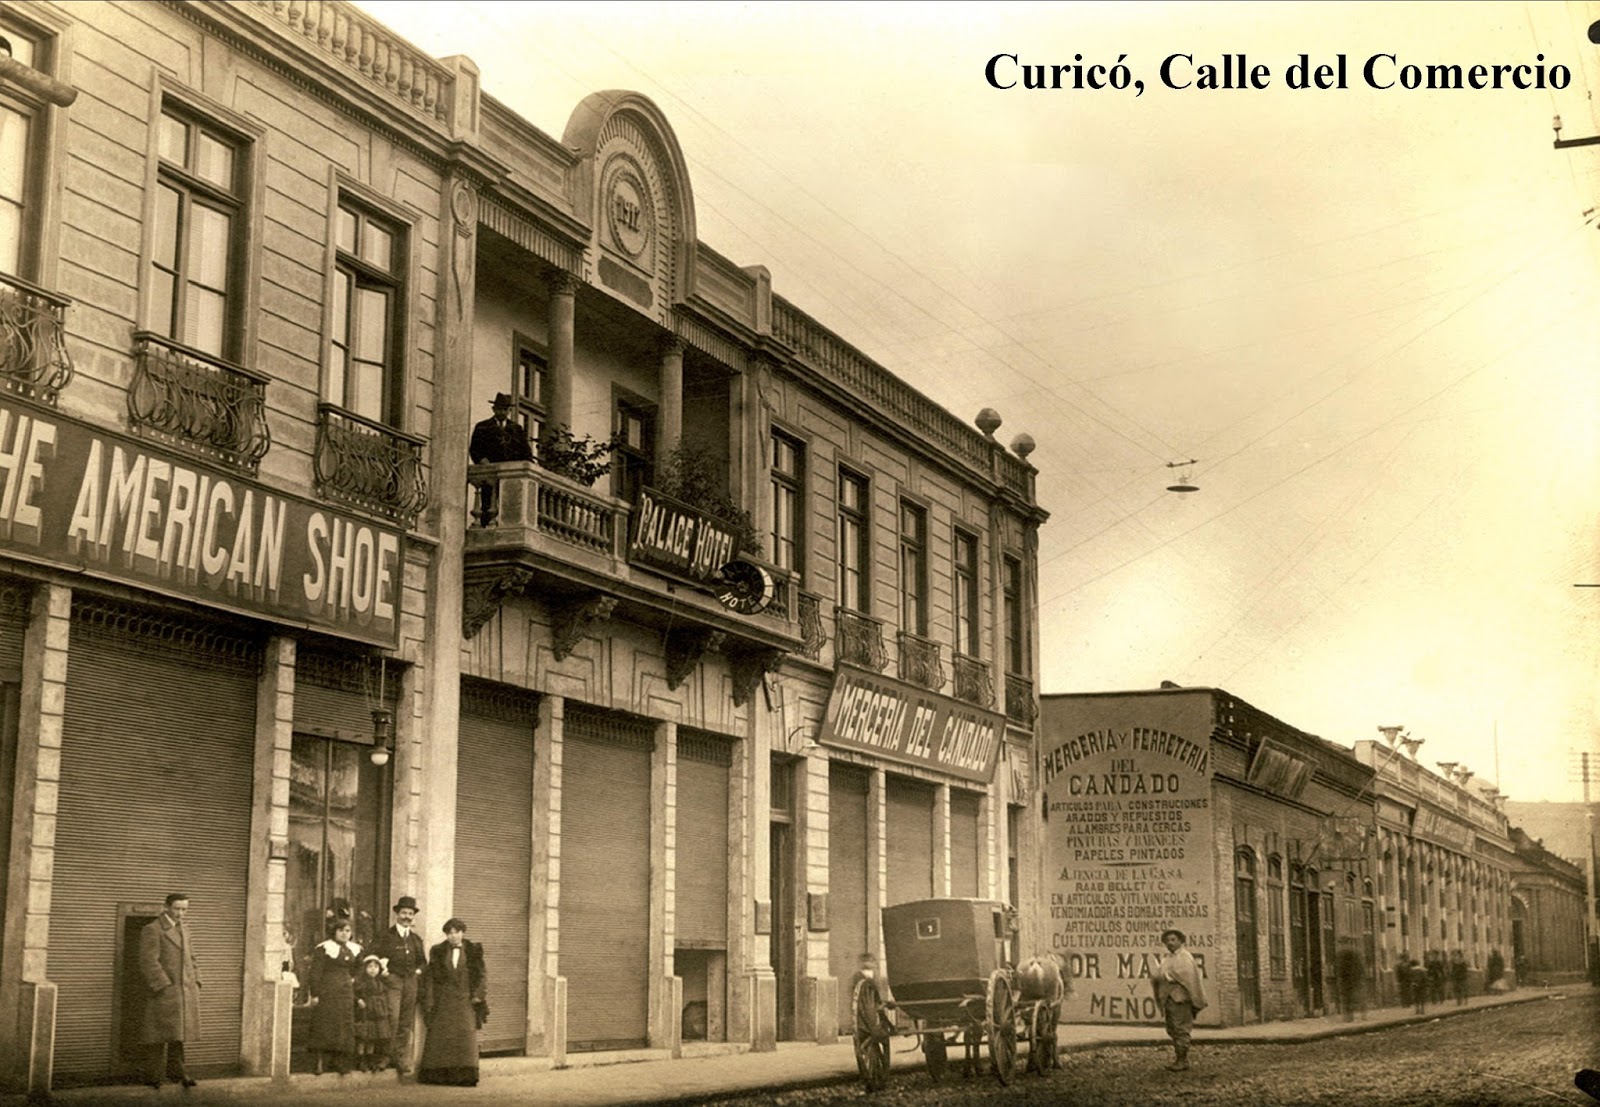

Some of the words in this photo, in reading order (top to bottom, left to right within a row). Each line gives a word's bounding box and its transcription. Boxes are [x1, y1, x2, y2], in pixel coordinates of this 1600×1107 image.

[68, 439, 288, 593] AMERICAN
[303, 512, 398, 620] SHOE
[632, 492, 695, 559] PALACE
[834, 683, 908, 751] MERCERIA
[906, 706, 937, 759] DEL
[938, 716, 994, 772] CANDADO
[1045, 729, 1117, 784] MERCERIA
[1118, 733, 1127, 746] Y
[1132, 728, 1208, 776] FERRETERIA
[1111, 759, 1140, 773] DEL
[1069, 774, 1180, 796] CANDADO
[1050, 801, 1094, 812] ARTICULOS
[1066, 812, 1108, 823] ARADOS
[1111, 812, 1119, 822] Y
[1122, 811, 1183, 822] REPUESTOS
[1069, 823, 1121, 834] ALAMBRES
[1122, 823, 1149, 833] PARA
[1152, 822, 1192, 833] CERCAS
[1075, 849, 1124, 861] PAPELES
[1130, 848, 1185, 860] PINTADOS
[1051, 893, 1064, 905] EN
[1066, 893, 1116, 905] ARTICULOS
[1127, 906, 1163, 918] BOMBAS
[1164, 905, 1209, 918] PRENSAS
[1065, 921, 1122, 933] ARTICULOS
[1053, 932, 1147, 949] CULTIVADORAS
[1068, 953, 1101, 979] OR
[1117, 953, 1208, 979] MAR
[1127, 985, 1137, 996] Y
[1090, 993, 1166, 1021] MENO
